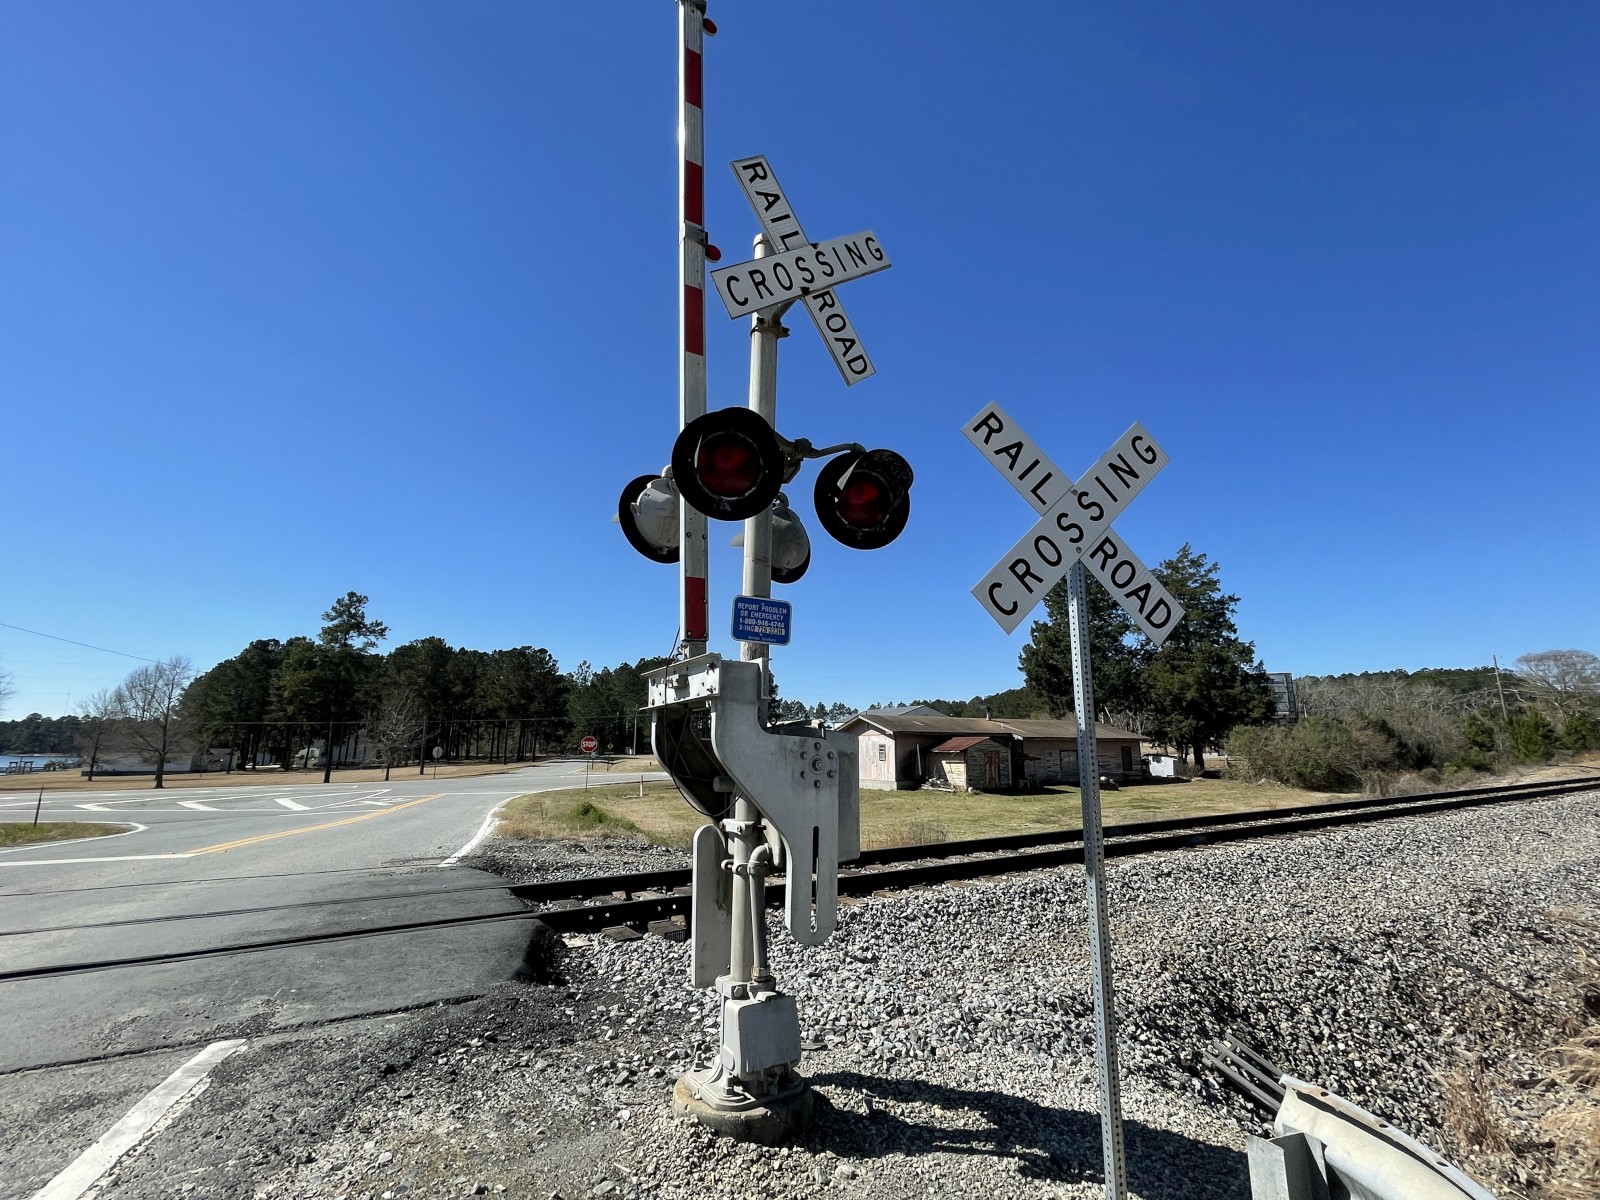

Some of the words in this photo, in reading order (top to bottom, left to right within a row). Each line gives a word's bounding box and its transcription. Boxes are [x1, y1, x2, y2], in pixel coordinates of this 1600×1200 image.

[741, 161, 800, 252] RAIL
[726, 236, 884, 307] CROSSING
[811, 289, 869, 376] ROAD
[972, 411, 1054, 506] RAIL
[988, 435, 1157, 616] CROSSING
[737, 602, 760, 611] REPORT
[761, 605, 787, 614] PROBLEM
[750, 611, 784, 621] EMERGENCY
[1089, 536, 1172, 630] ROAD
